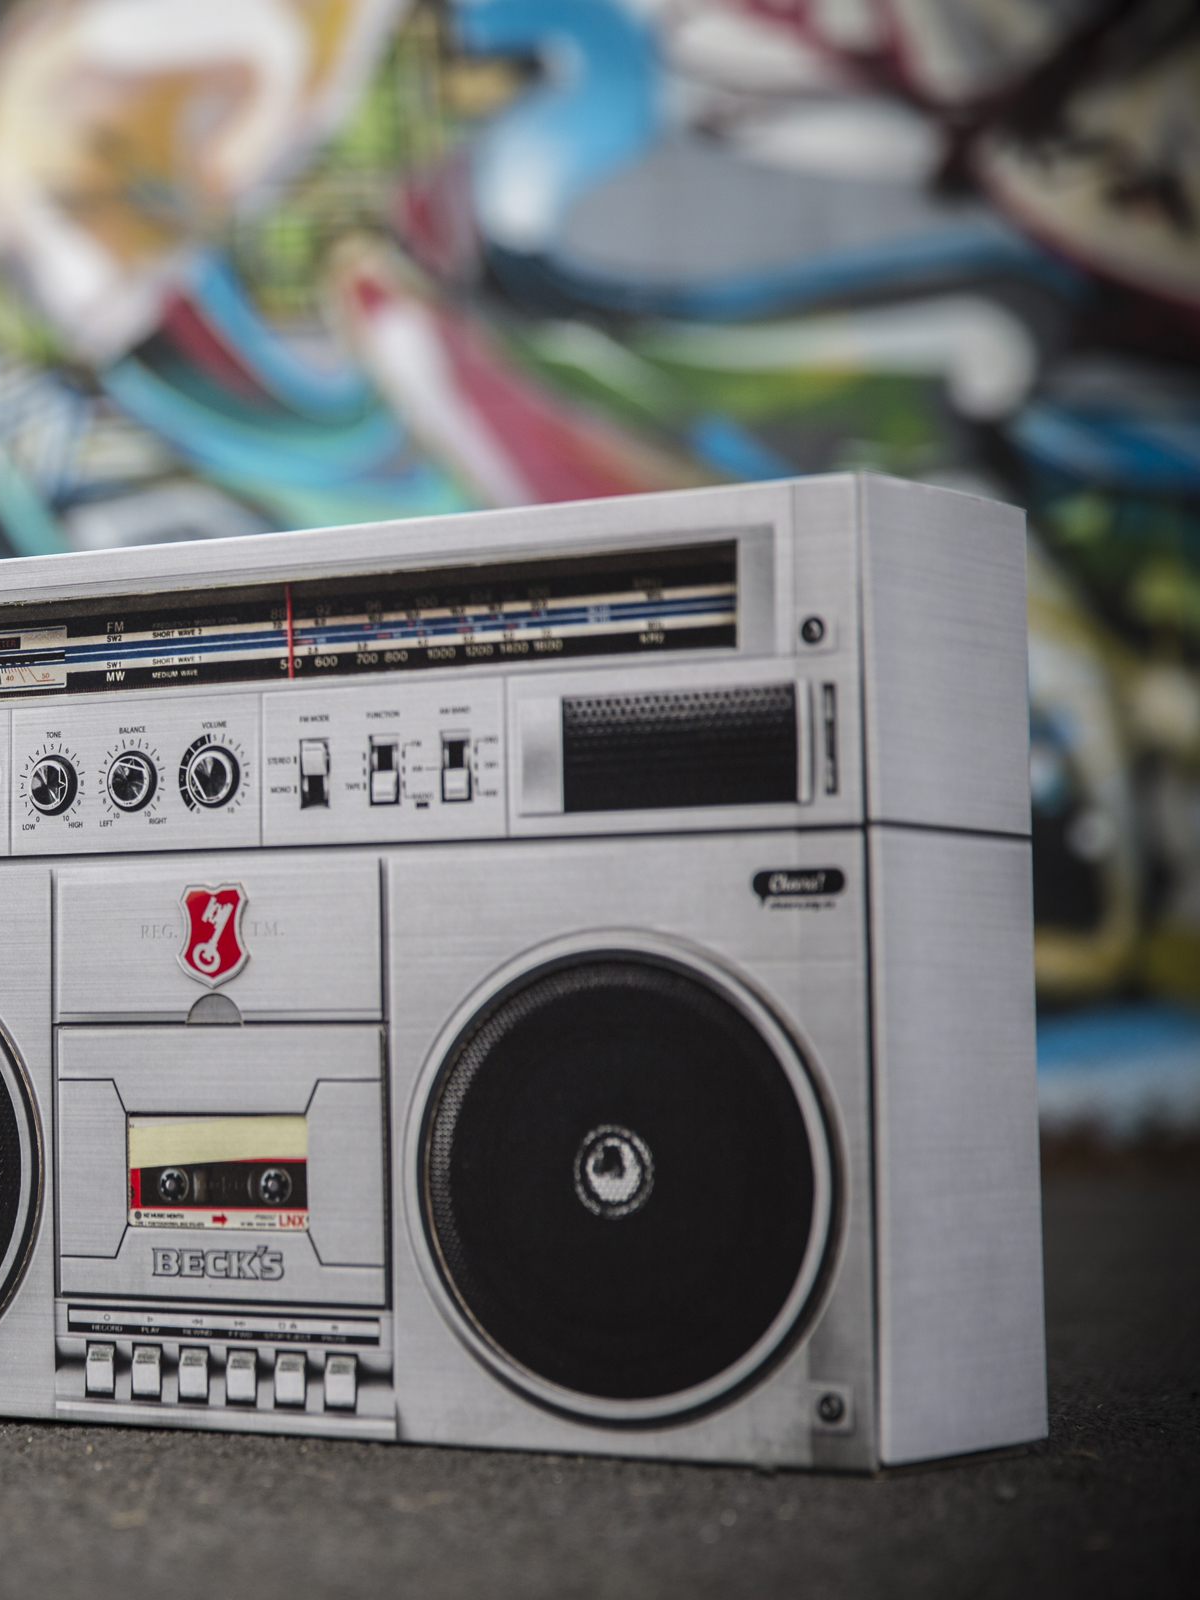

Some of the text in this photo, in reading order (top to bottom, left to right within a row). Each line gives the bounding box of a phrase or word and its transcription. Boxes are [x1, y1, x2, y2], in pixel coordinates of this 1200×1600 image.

[106, 621, 125, 633] FM
[106, 635, 122, 643] SW2
[152, 630, 175, 639] SHORT
[178, 628, 195, 637] WAVE
[106, 661, 122, 669] SW1
[152, 657, 174, 666] SHORT
[178, 655, 195, 663] WAVE
[314, 655, 338, 668] 600
[356, 652, 379, 665] 700
[5, 674, 15, 682] 40
[41, 672, 50, 680] 50
[105, 668, 198, 682] MW MEDIUM WAVE
[366, 709, 400, 719] FUNCTION
[119, 726, 146, 734] BALANCE
[202, 721, 227, 729] VOLUME
[267, 757, 291, 765] STEREO
[270, 785, 291, 794] MONO
[141, 924, 178, 939] REG.
[279, 1214, 305, 1228] LNX
[152, 1245, 285, 1281] BECK'S
[92, 1325, 122, 1333] RECORD
[183, 1329, 212, 1337] REWIND
